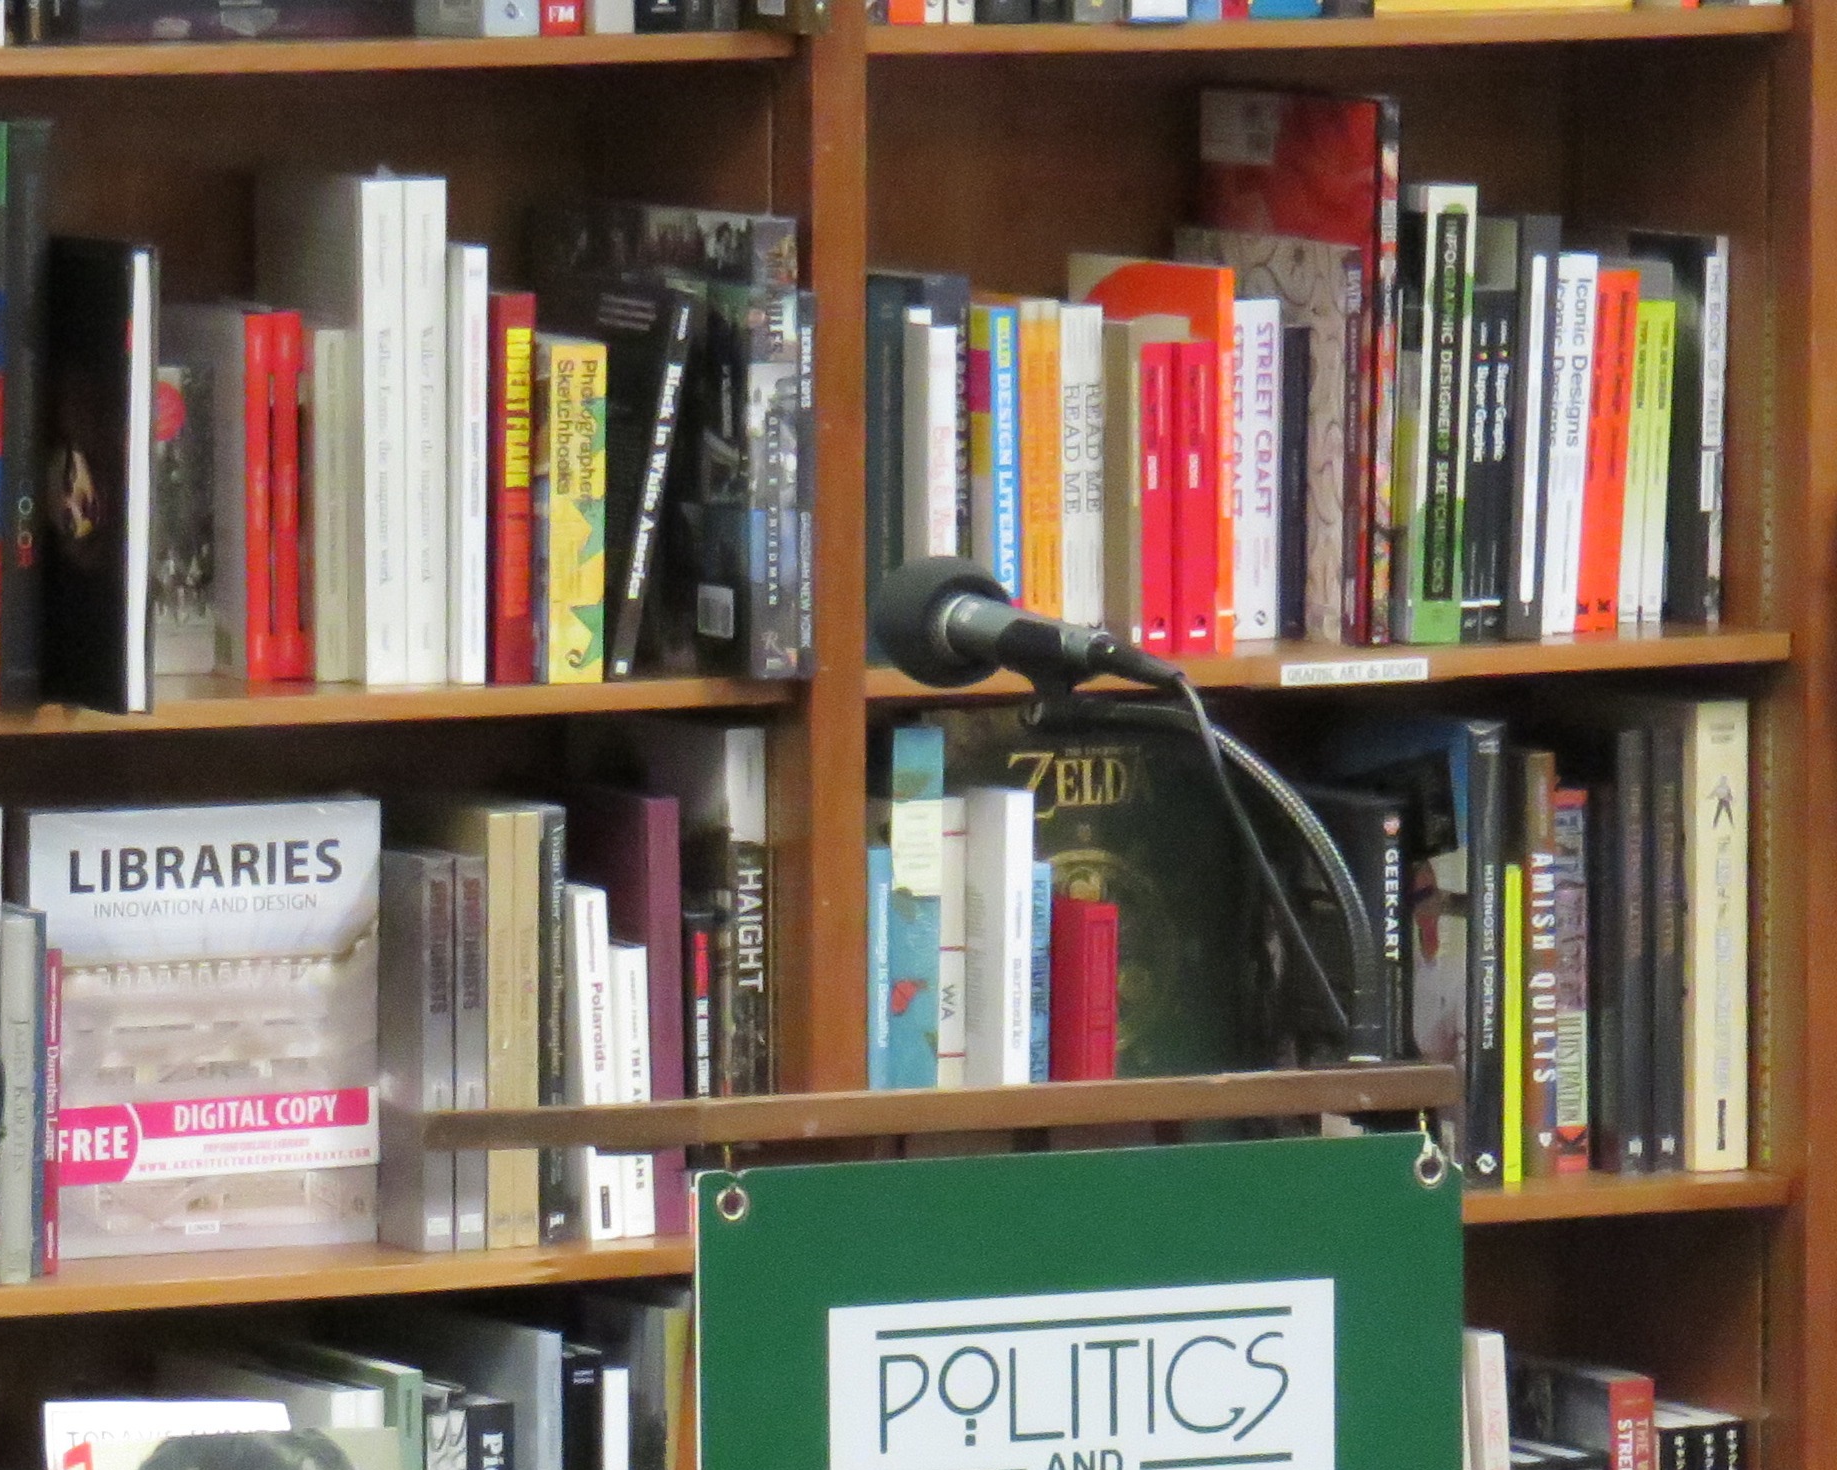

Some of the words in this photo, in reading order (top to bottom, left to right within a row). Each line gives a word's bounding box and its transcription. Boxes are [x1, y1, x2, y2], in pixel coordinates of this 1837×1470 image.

[1571, 277, 1592, 346] Iconic
[658, 363, 684, 419] Black
[1254, 321, 1274, 418] STREET
[1471, 364, 1488, 406] Super
[1492, 362, 1509, 404] Super
[1565, 354, 1589, 447] Designs
[555, 358, 575, 496] Sketchbooks
[997, 370, 1014, 466] DESIGN
[1064, 384, 1081, 461] READ
[1085, 383, 1102, 461] READ
[1470, 407, 1485, 463] Graphic
[1491, 406, 1507, 461] Graphic
[642, 450, 668, 511] White
[1063, 472, 1081, 515] ME
[1085, 471, 1102, 514] ME
[1254, 428, 1274, 518] CRAFT
[628, 515, 658, 600] America
[998, 471, 1015, 593] LITERACY
[1007, 750, 1139, 820] ZELD
[69, 838, 343, 894] LIBRARIES
[1530, 852, 1555, 950] AMISH
[93, 899, 205, 919] INNOVATION
[208, 896, 249, 914] AND
[252, 893, 318, 911] DESIGN
[737, 867, 764, 993] HAIGHT
[1383, 848, 1400, 961] GEEK-ART
[590, 981, 606, 1073] Polaroids
[1482, 964, 1495, 1050] PORTRAITS
[1530, 971, 1556, 1084] QUILTS
[44, 1045, 59, 1114] Dorothea
[173, 1098, 269, 1134] DIGITAL
[274, 1093, 338, 1125] COPY
[43, 1115, 59, 1161] Lange
[57, 1125, 130, 1164] FREE
[878, 1331, 1290, 1454] POLITICS
[1637, 1418, 1650, 1456] THE
